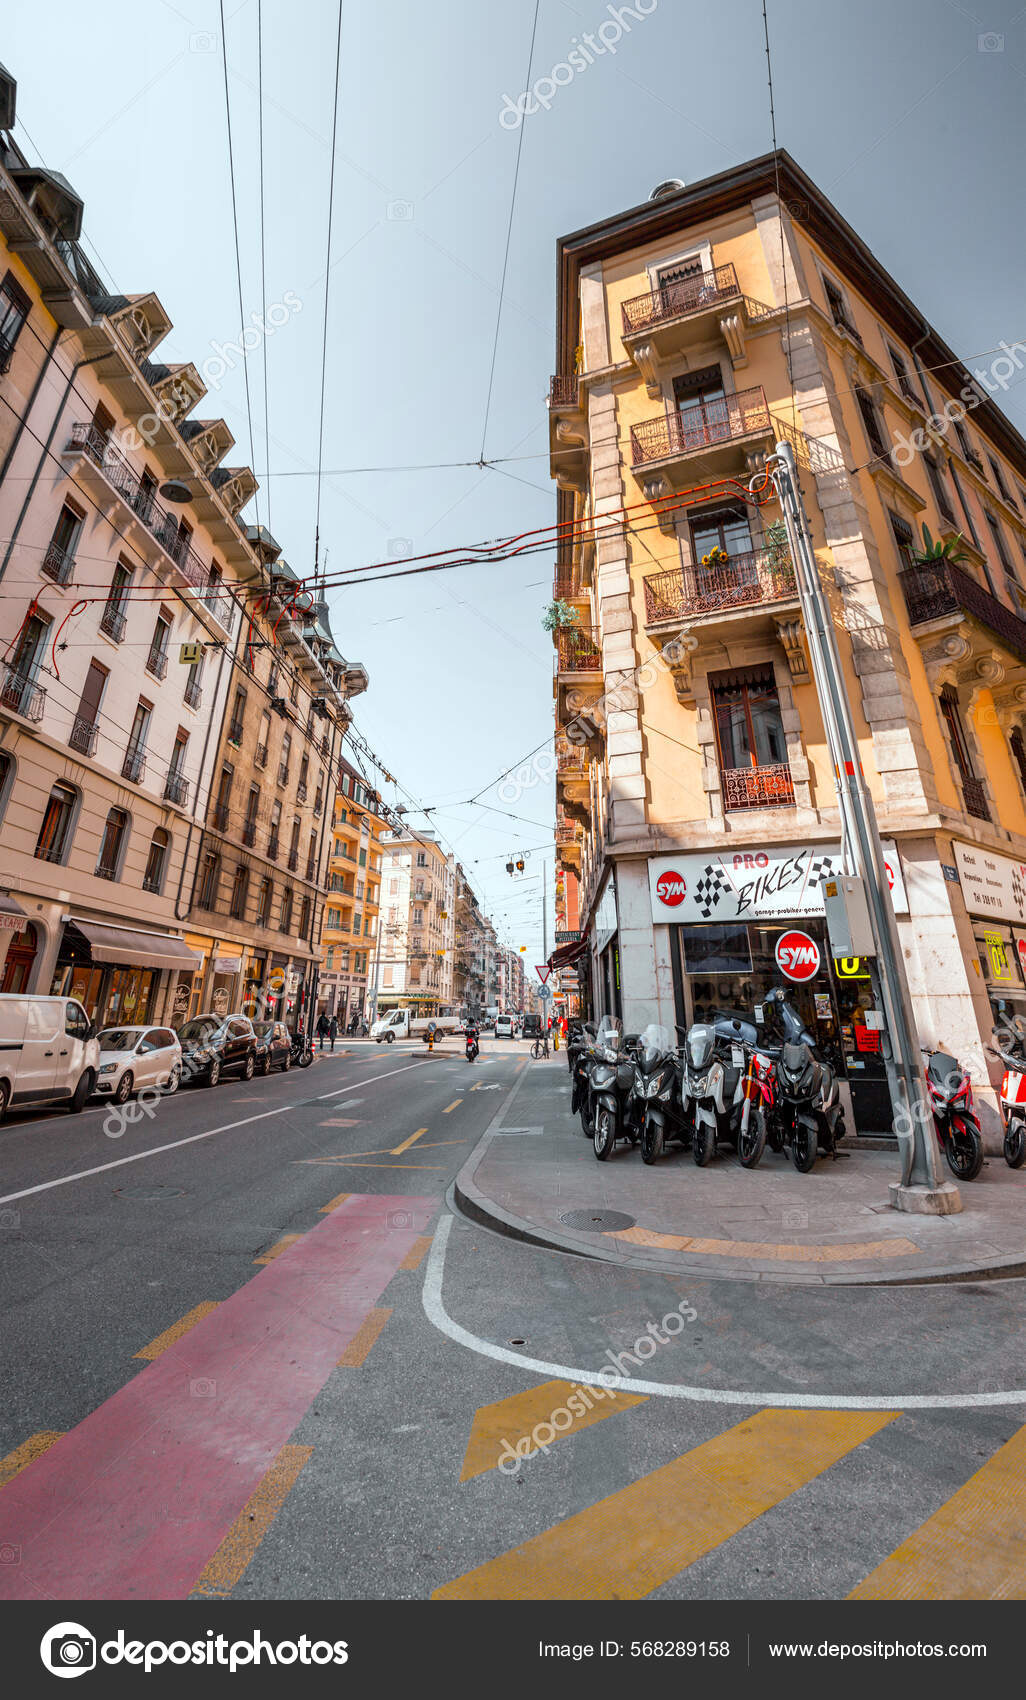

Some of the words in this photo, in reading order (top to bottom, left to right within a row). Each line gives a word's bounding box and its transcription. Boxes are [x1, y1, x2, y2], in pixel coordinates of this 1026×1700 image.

[733, 852, 769, 870] PRO
[656, 881, 687, 897] SYM
[736, 850, 807, 915] BIKES
[778, 946, 820, 966] SYM
